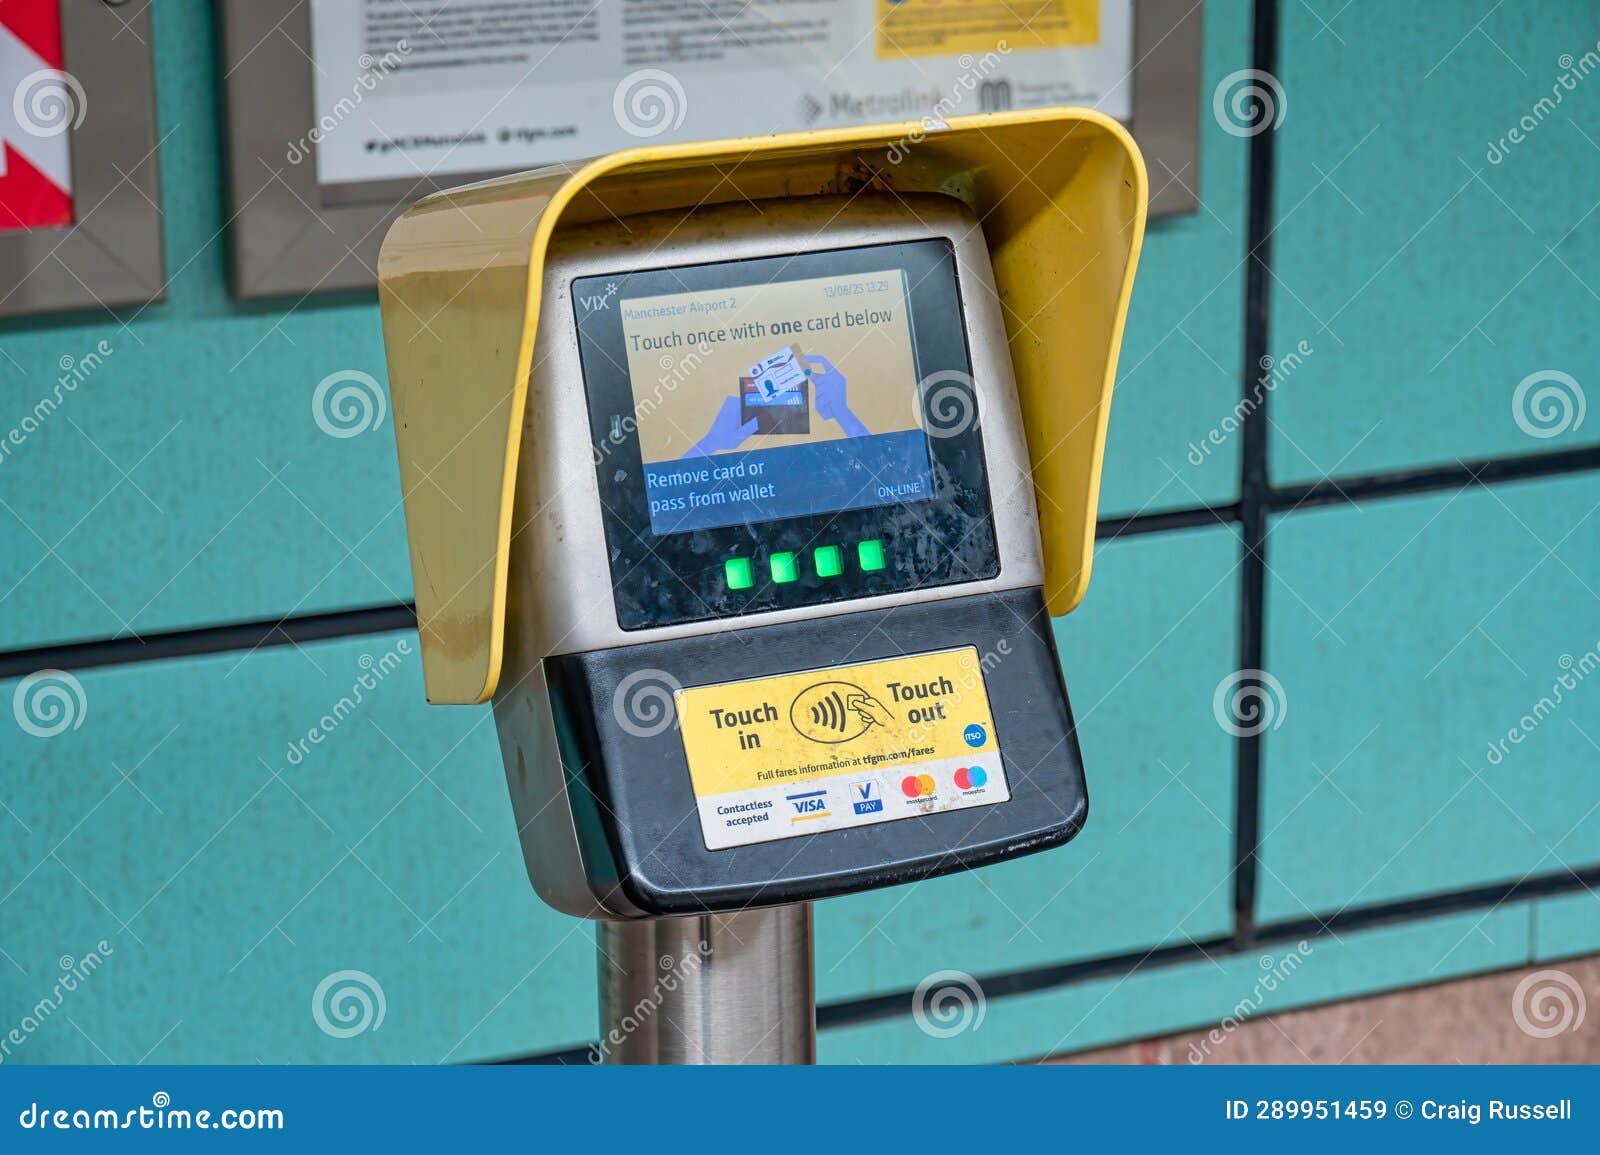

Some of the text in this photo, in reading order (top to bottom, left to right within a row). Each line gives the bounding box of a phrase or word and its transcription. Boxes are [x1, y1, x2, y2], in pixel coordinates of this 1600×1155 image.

[580, 295, 611, 311] VIX
[624, 298, 737, 320] Manchester Airport 2
[630, 308, 892, 351] Touch once with one card below
[647, 461, 765, 488] Remove card or
[651, 483, 776, 516] pass from wallet
[878, 482, 921, 498] ON-LINE
[886, 676, 954, 702] Touch
[709, 702, 779, 729] Touch
[908, 702, 947, 724] out
[738, 730, 761, 750] in
[757, 746, 935, 781] Full fares information at tfgm.com/fares
[906, 795, 938, 805] mastercard
[962, 788, 986, 796] maestro
[717, 800, 773, 815] Contactless
[792, 799, 826, 813] VISA
[859, 801, 877, 812] PAY
[726, 812, 769, 827] accepted
